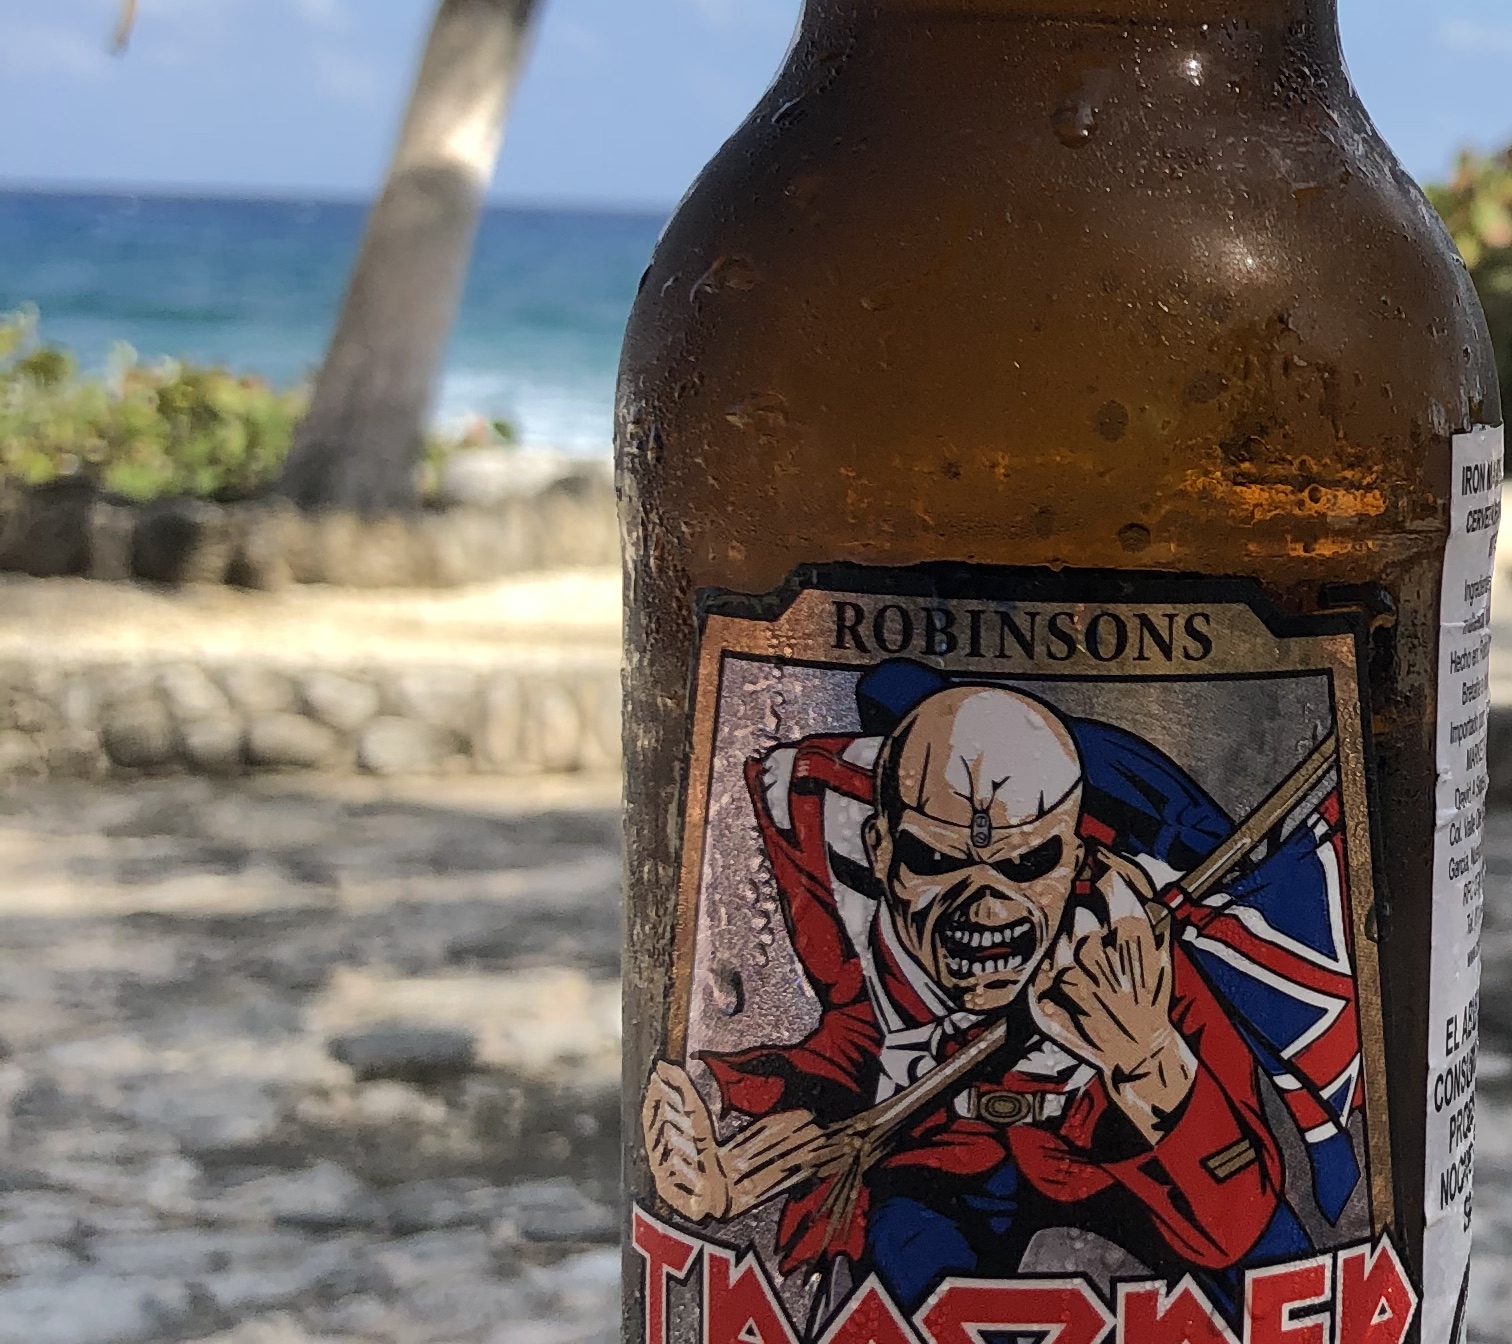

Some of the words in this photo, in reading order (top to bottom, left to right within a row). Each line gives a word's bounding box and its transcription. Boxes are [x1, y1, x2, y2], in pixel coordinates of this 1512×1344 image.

[1461, 464, 1485, 496] IRON
[831, 600, 1214, 663] ROBINSONS
[1445, 1014, 1460, 1058] EL
